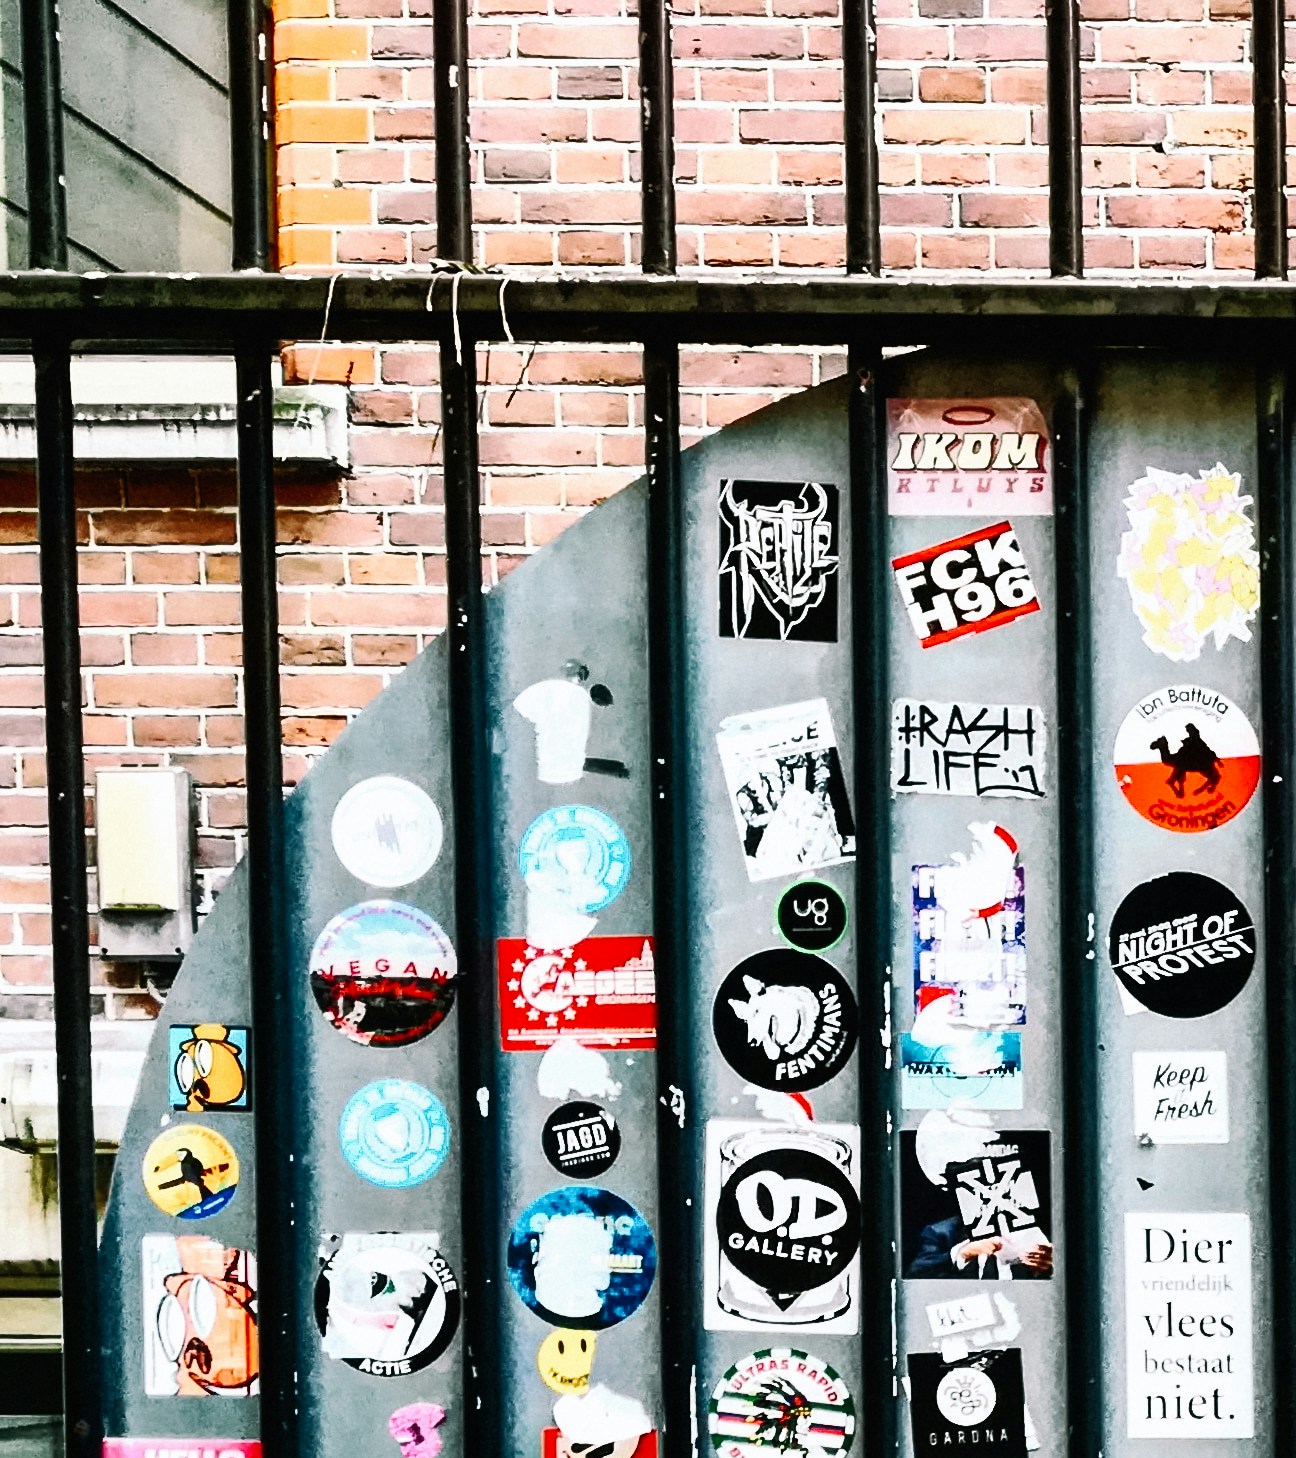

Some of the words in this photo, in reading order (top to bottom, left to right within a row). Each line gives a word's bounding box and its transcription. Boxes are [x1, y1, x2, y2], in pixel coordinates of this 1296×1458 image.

[892, 432, 1046, 473] IKOM
[896, 532, 1026, 603] FCK
[908, 575, 1036, 638] H96
[1136, 697, 1163, 719] Ibn
[1168, 688, 1229, 715] Battuta
[1149, 800, 1237, 828] Groningen
[1119, 921, 1198, 965] NIGHT
[1203, 910, 1239, 940] OF
[317, 958, 449, 985] VEGAN
[1123, 934, 1254, 985] PROTEST
[776, 982, 843, 1080] FENTIMANS
[1153, 1063, 1209, 1090] Keep
[556, 1123, 607, 1154] JAGD
[728, 1232, 838, 1267] GALLERY
[1144, 1228, 1234, 1264] Dier
[1141, 1274, 1234, 1296] vriendelijk
[1143, 1302, 1235, 1338] vlees
[358, 1359, 412, 1376] ACTIE
[1143, 1351, 1235, 1375] bestaat
[731, 1359, 789, 1391] ULTRAS
[798, 1359, 838, 1403] RAPID
[1144, 1384, 1236, 1421] niet.
[929, 1432, 1009, 1446] GARDNA
